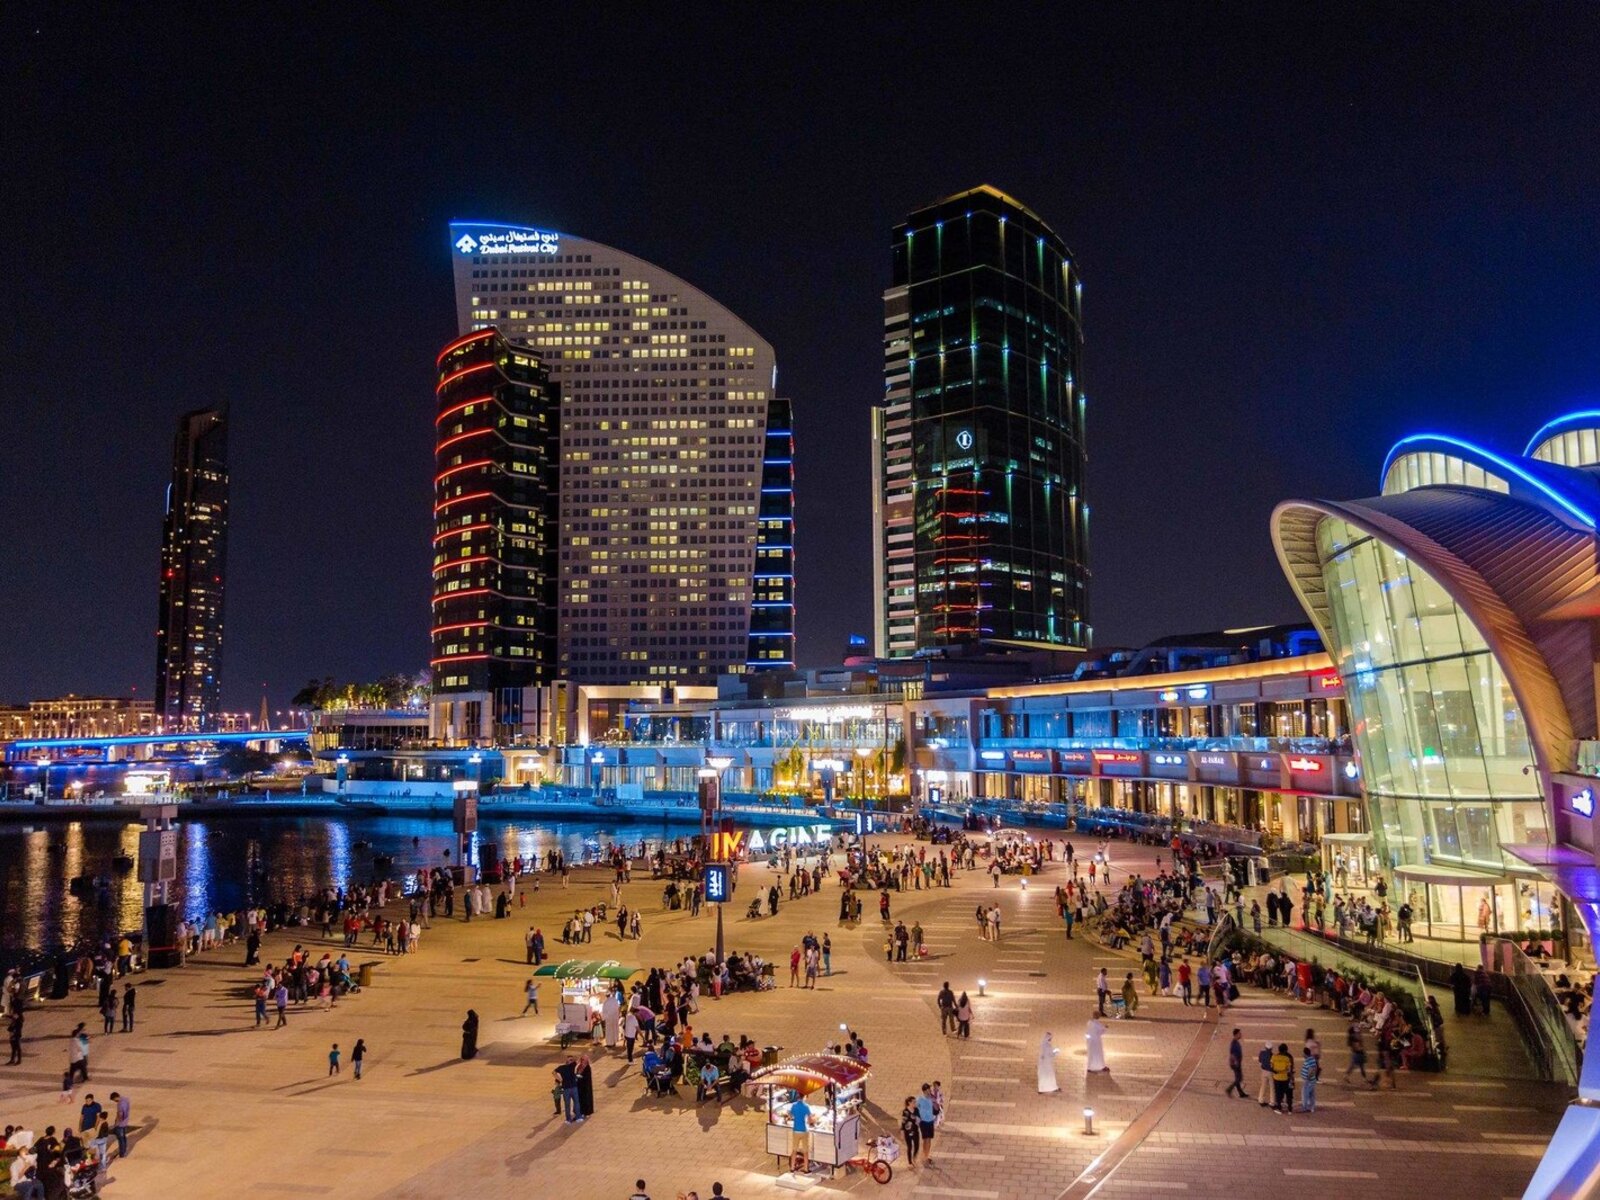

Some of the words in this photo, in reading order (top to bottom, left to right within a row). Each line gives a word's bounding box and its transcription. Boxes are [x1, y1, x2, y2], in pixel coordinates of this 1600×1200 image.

[479, 244, 507, 254] Dubai
[508, 243, 540, 253] Festival
[540, 243, 558, 254] City
[710, 824, 832, 860] IMAGINE
